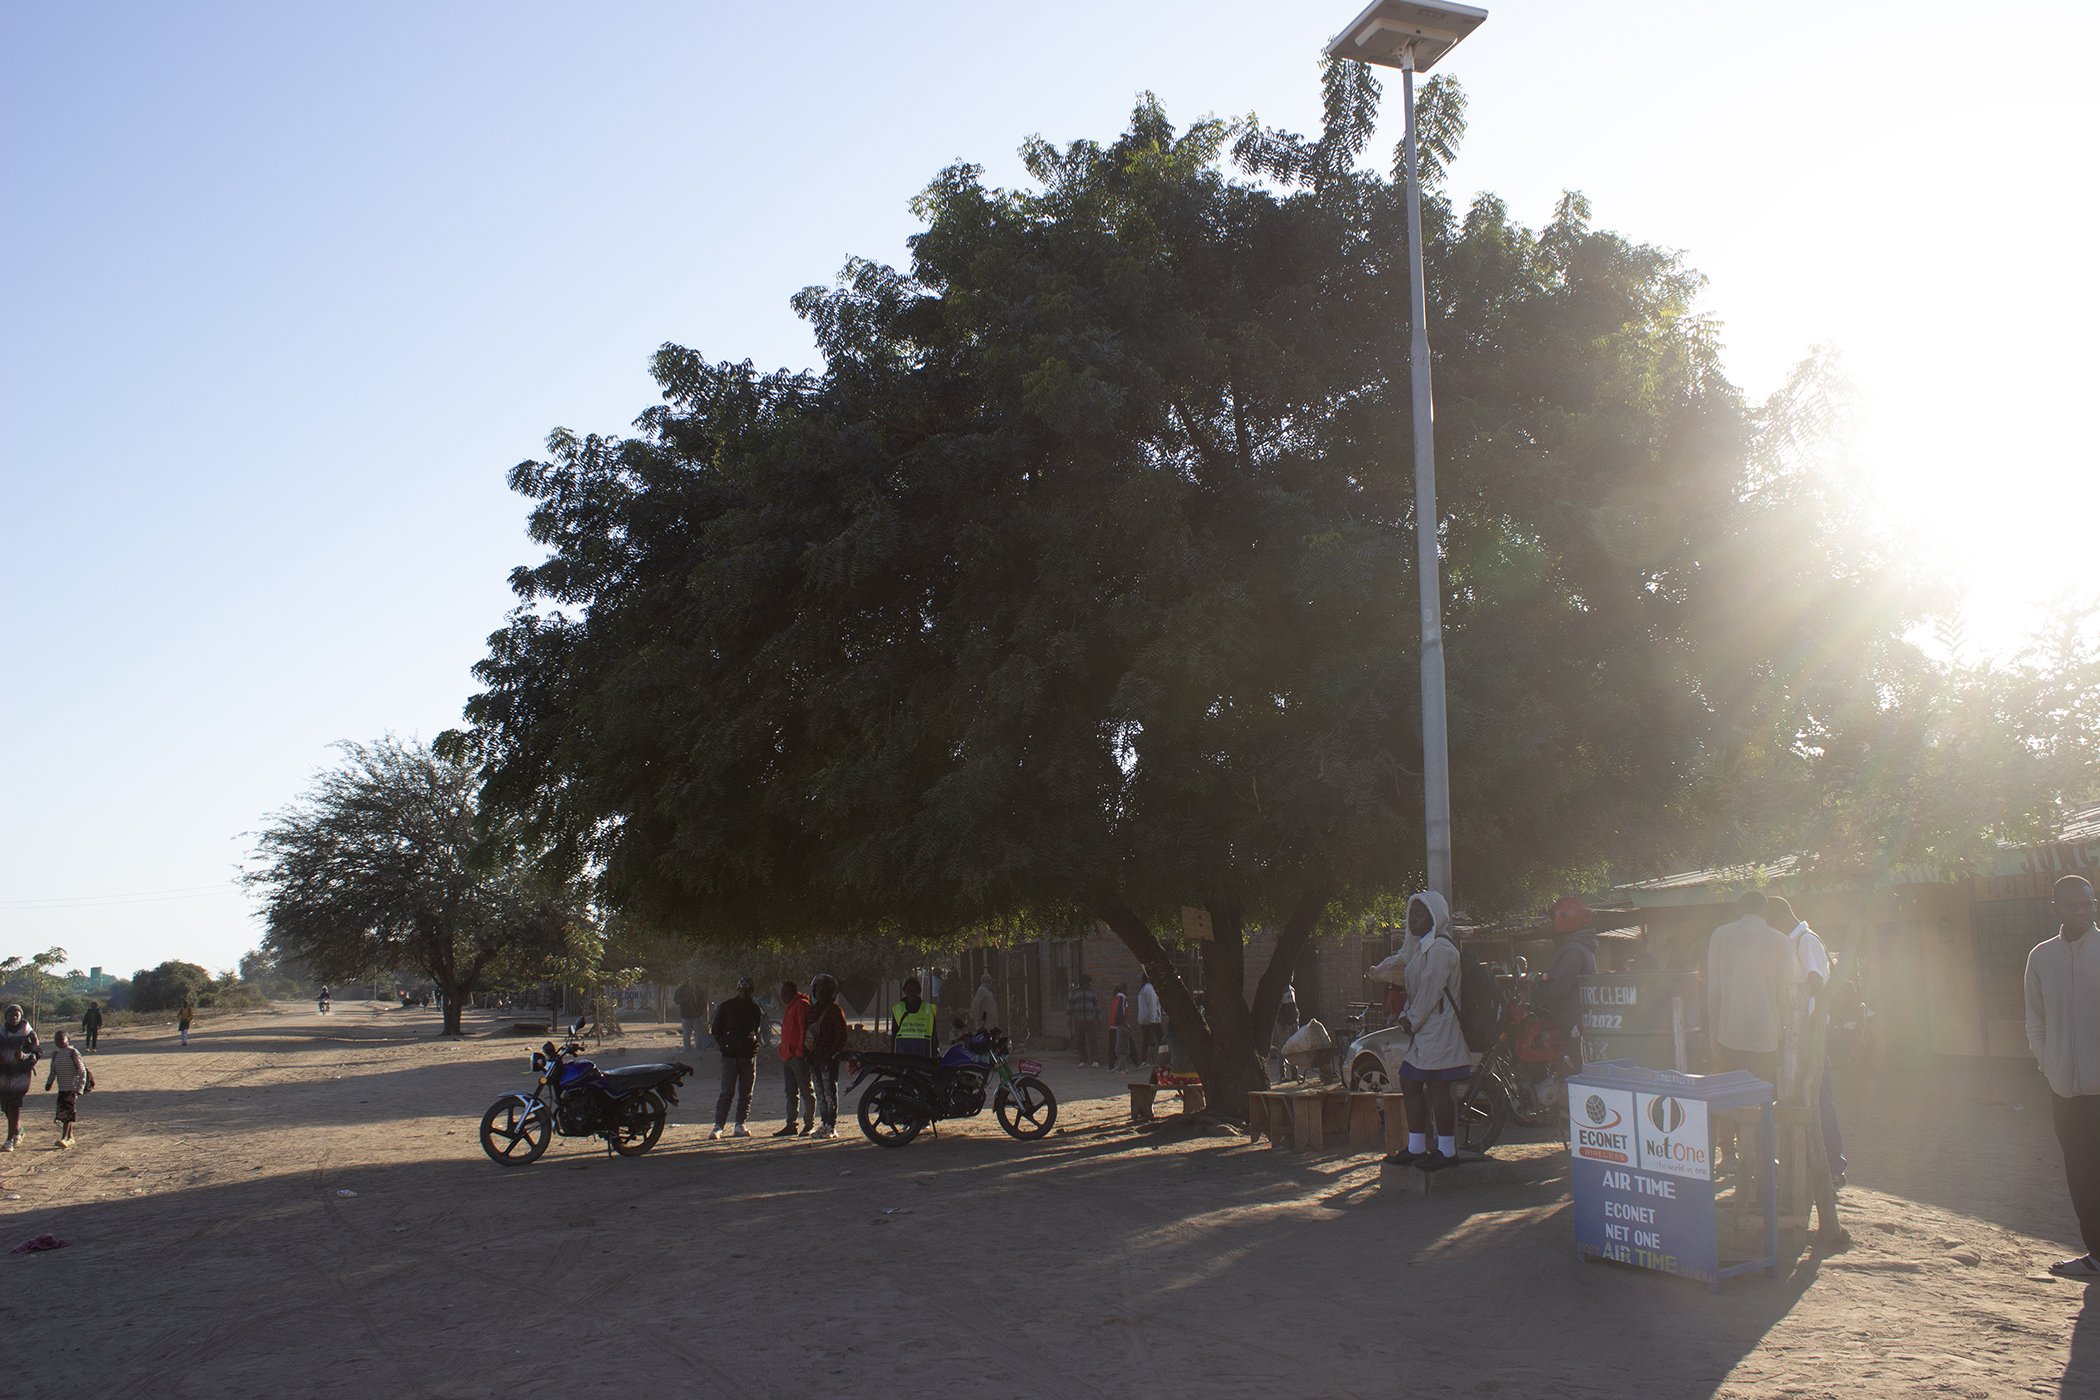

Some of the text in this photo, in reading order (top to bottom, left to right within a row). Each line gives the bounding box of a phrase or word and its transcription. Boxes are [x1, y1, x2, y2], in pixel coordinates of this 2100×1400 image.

[1579, 1130, 1627, 1150] ECONET
[1584, 1148, 1626, 1162] WIRELESS
[1602, 1169, 1676, 1200] AIR TIME
[1605, 1201, 1655, 1224] ECONET
[1605, 1223, 1661, 1250] NET ONE
[1602, 1241, 1632, 1264] AIR
[1635, 1248, 1678, 1274] TIME
